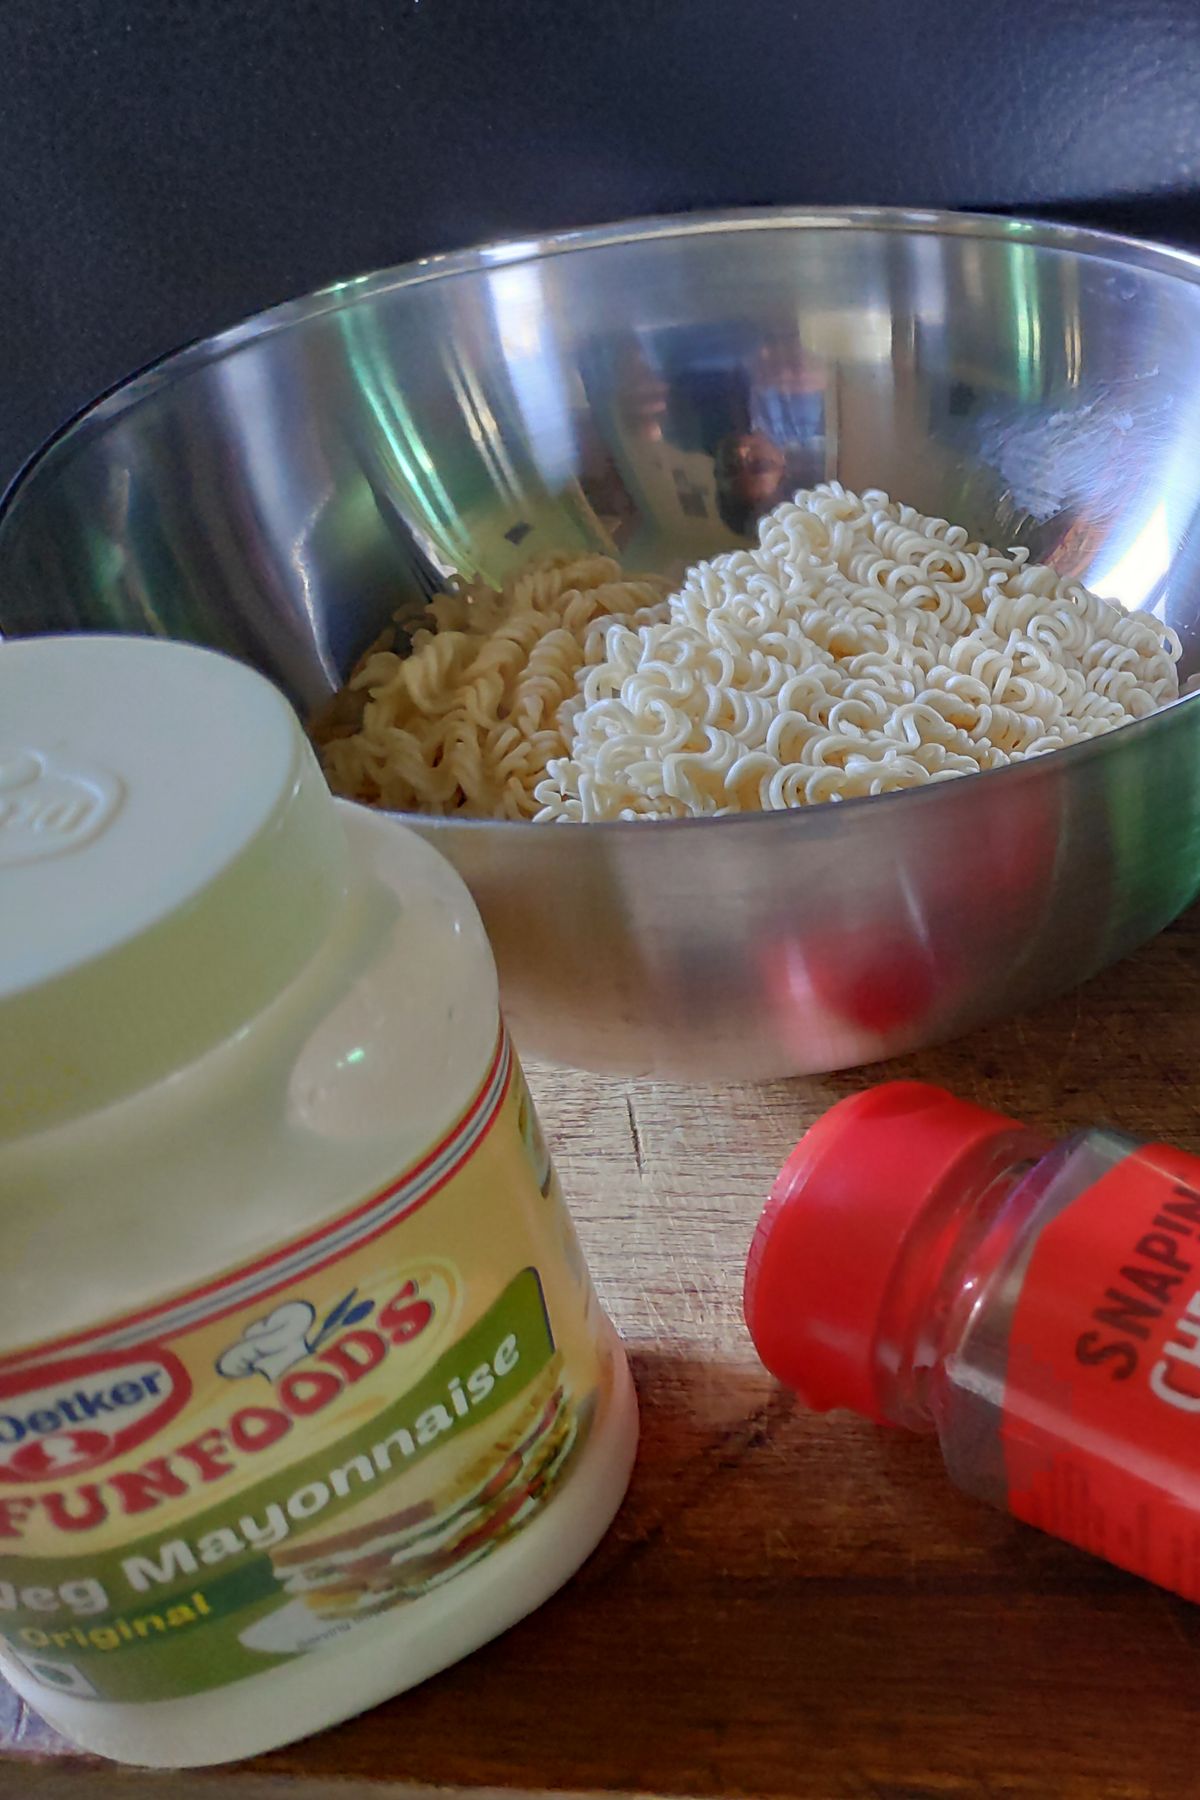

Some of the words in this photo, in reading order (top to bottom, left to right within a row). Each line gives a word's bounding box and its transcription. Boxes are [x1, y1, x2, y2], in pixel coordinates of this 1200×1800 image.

[0, 1279, 434, 1537] FUNFOODS
[121, 1333, 520, 1592] Mayonnaise
[20, 1591, 211, 1650] Original
